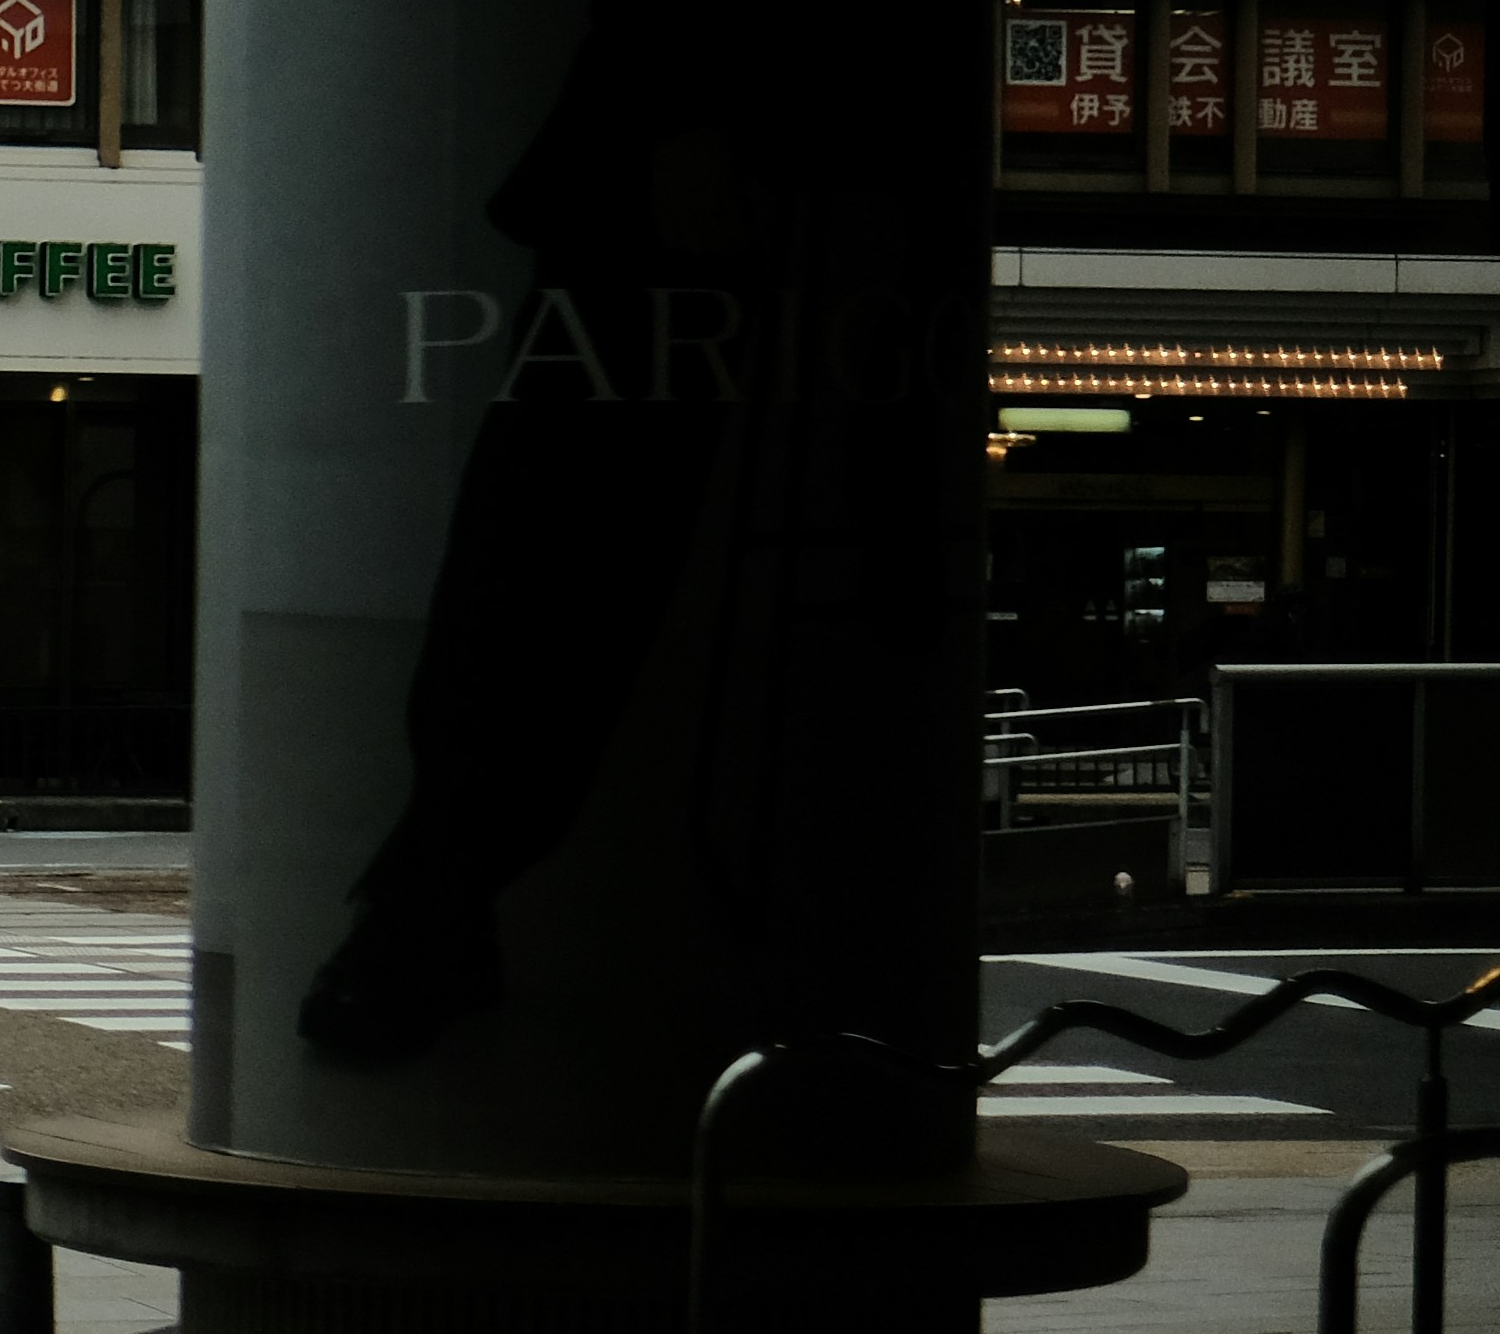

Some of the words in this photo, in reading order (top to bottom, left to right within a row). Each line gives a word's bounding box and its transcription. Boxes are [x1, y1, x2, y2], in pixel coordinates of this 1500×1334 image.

[1073, 24, 1382, 89] 貸会議室
[1069, 92, 1319, 131] 伊予鉄不動産
